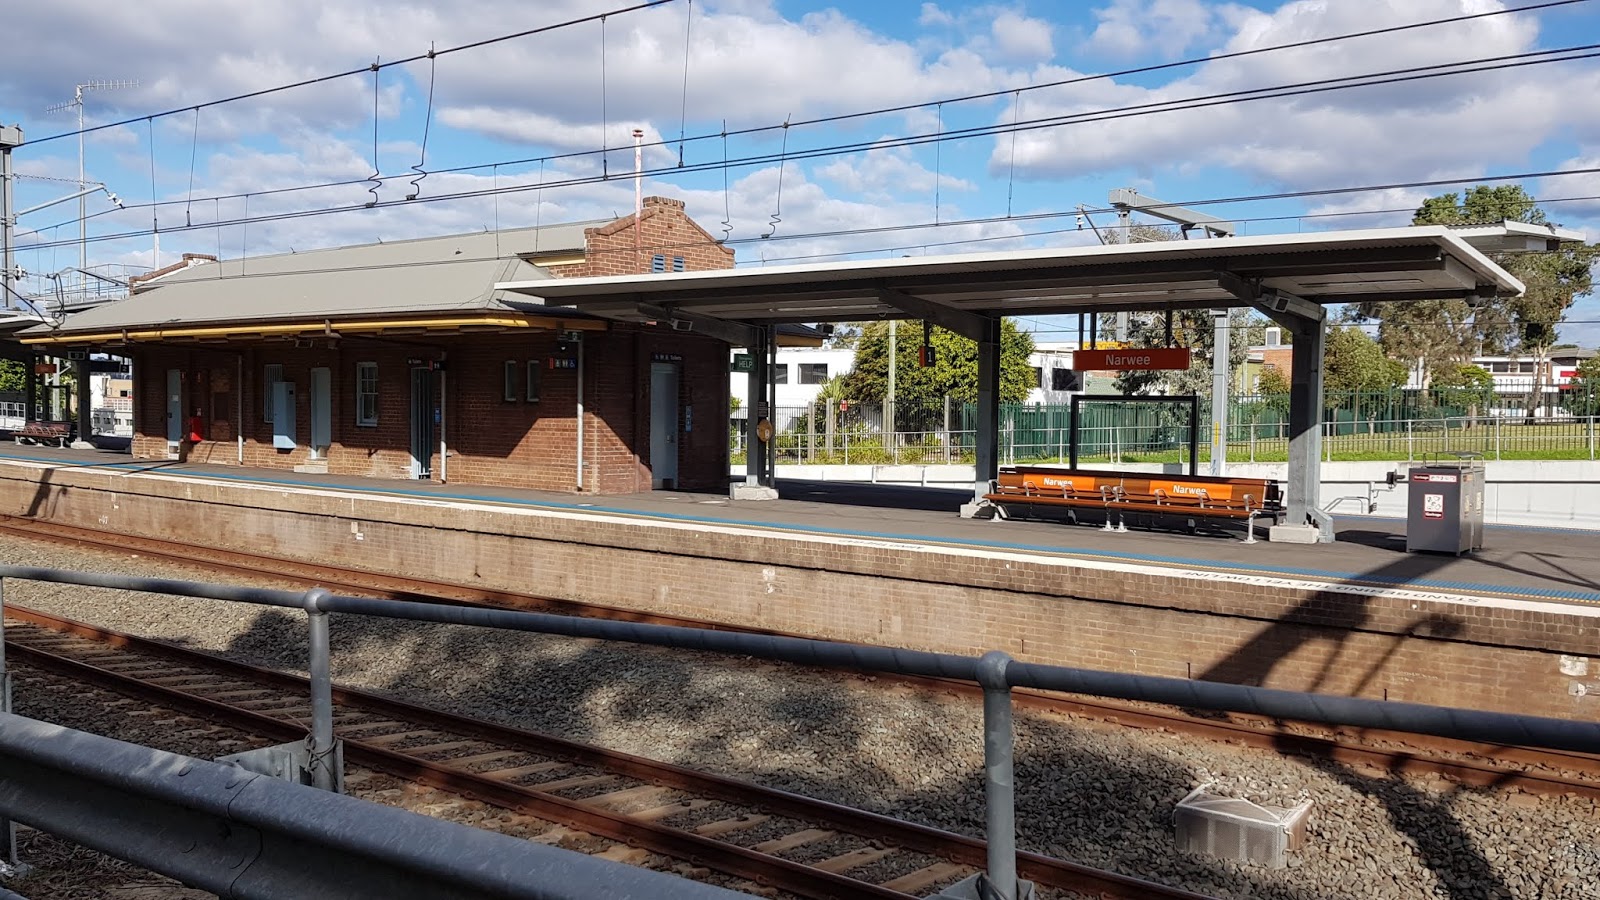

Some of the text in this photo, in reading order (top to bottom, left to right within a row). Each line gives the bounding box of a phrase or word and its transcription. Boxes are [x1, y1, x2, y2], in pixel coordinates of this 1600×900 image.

[927, 351, 933, 363] 1
[1105, 354, 1151, 366] Narwee
[739, 360, 753, 368] HELP
[1043, 477, 1073, 487] Narwee
[1172, 484, 1207, 495] Narwee
[1225, 575, 1292, 586] YELLOW
[1335, 585, 1409, 596] BEHIND
[1413, 592, 1481, 603] STAND
